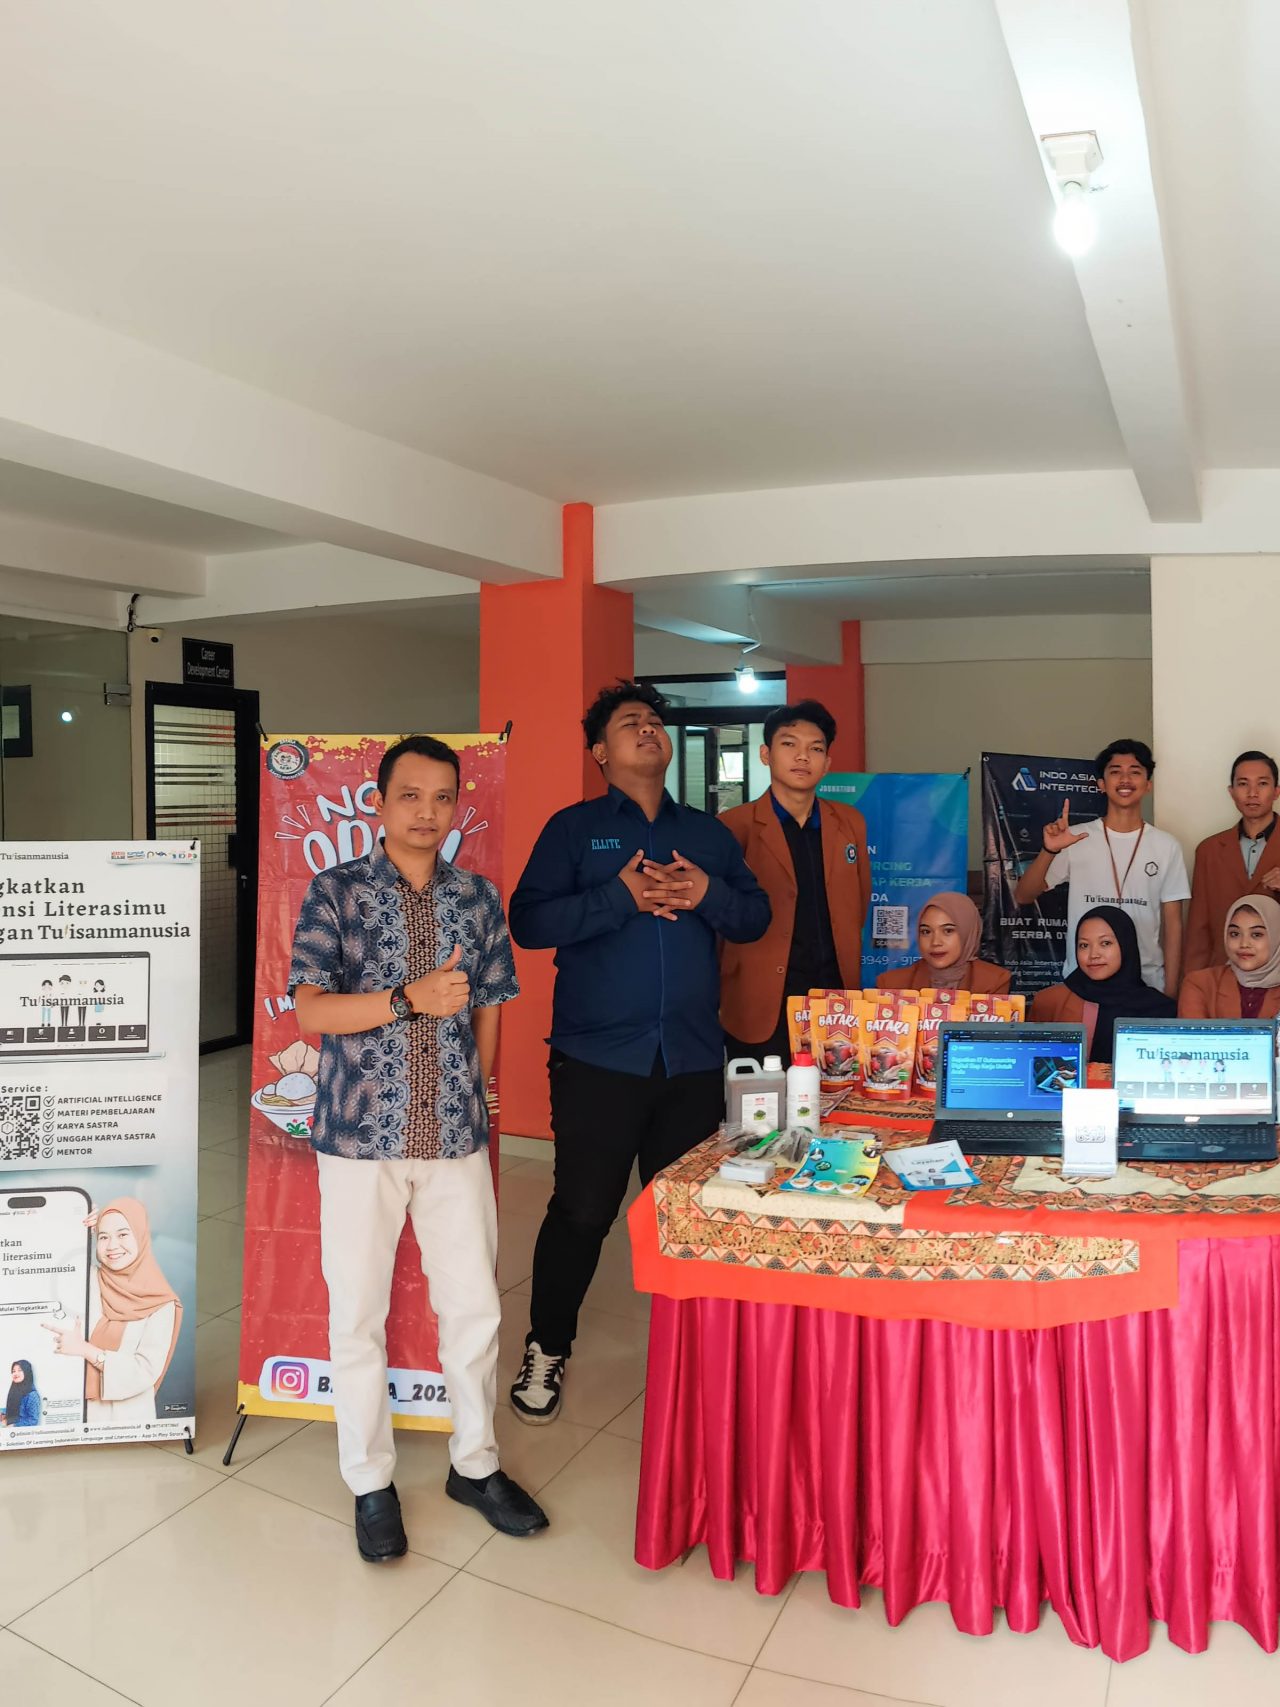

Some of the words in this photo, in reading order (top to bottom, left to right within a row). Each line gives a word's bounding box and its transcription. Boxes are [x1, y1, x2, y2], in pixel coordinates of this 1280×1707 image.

[1040, 771, 1068, 780] INDO
[1070, 773, 1096, 782] ASIA
[591, 838, 621, 850] ELLITE
[44, 899, 166, 917] Literasimu
[1011, 930, 1052, 940] SERBA
[866, 1019, 911, 1035] BATARA
[1, 1085, 42, 1094] Service
[58, 1096, 102, 1105] ARTIFICIAL
[104, 1094, 162, 1103] INTELLIGENCE
[58, 1109, 89, 1117] MATERI
[90, 1107, 155, 1116] PEMBELAJARAN
[57, 1122, 85, 1130] KARYA
[86, 1121, 118, 1129] SASTRA
[57, 1134, 93, 1143] UNGGAH
[95, 1133, 122, 1142] KARYA
[124, 1132, 156, 1141] SASTRA
[57, 1148, 92, 1156] MENTOR
[3, 1251, 52, 1261] literasimu
